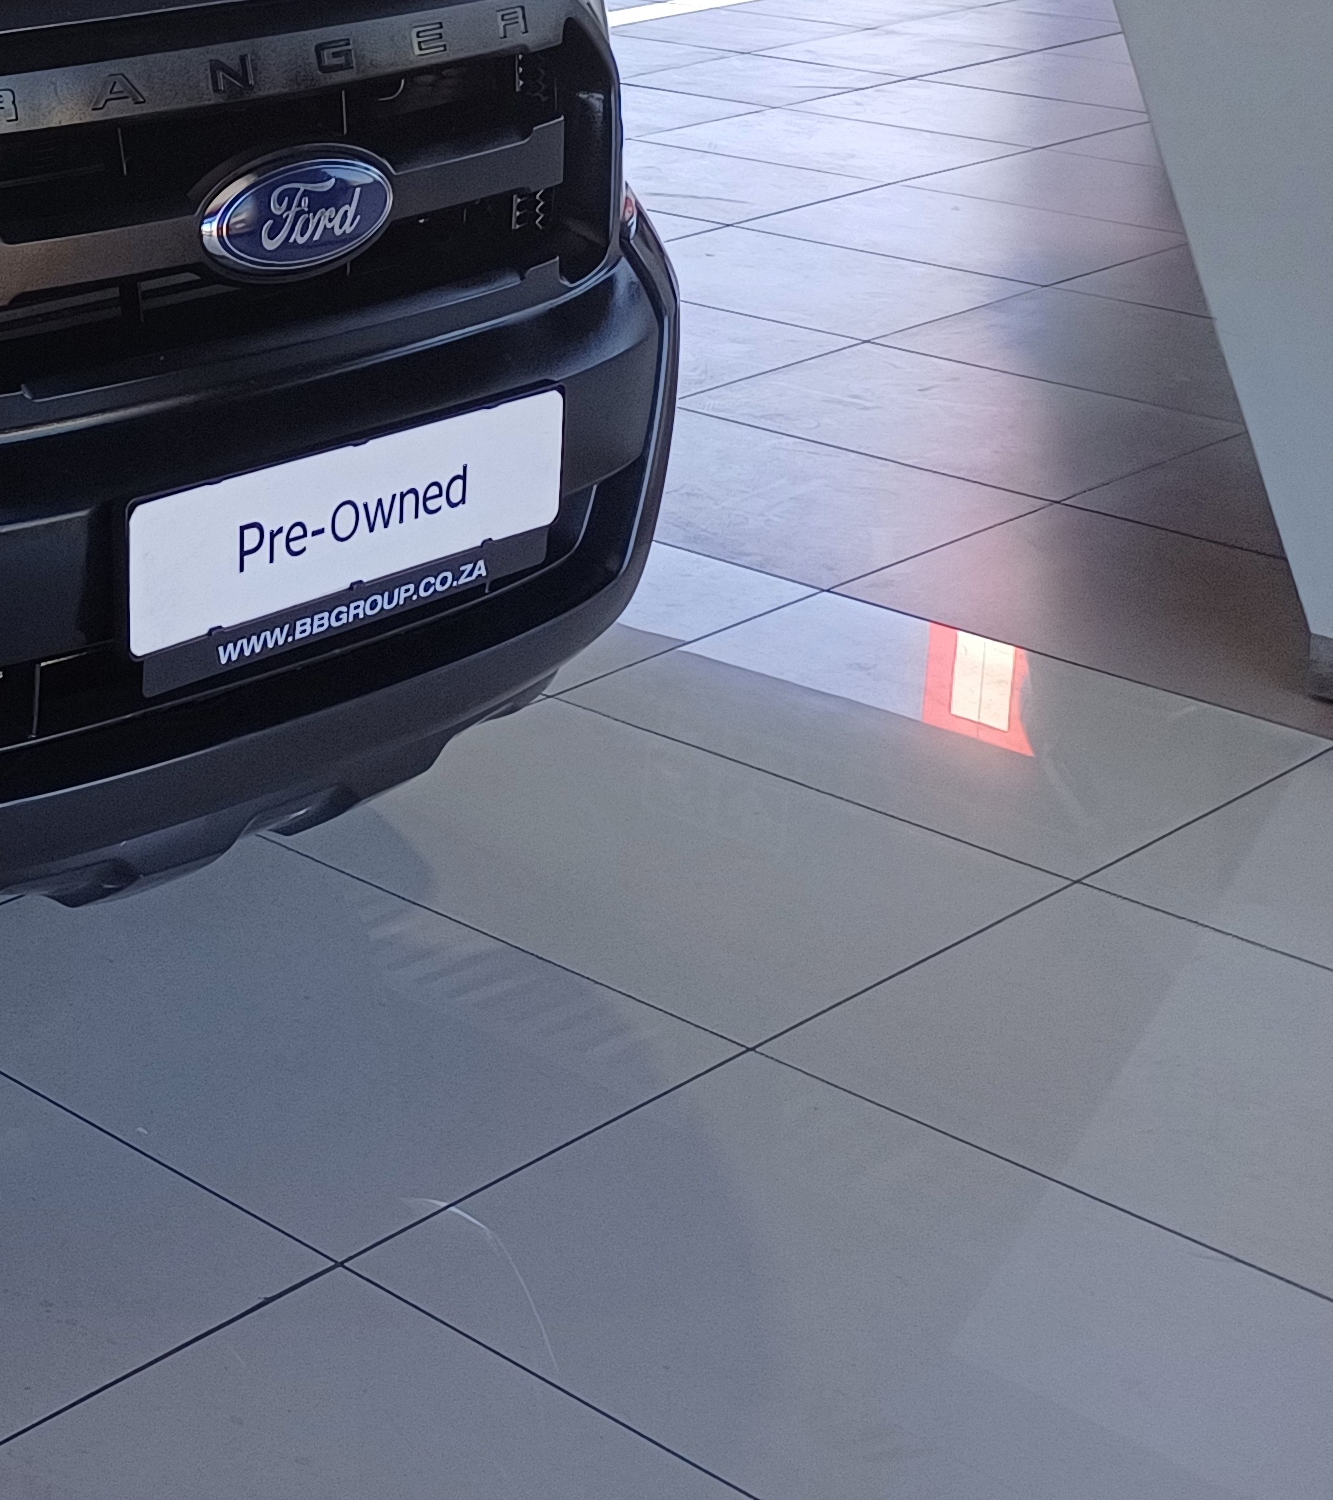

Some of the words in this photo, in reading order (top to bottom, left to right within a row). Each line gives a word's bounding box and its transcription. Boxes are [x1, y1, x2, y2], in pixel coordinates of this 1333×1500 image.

[262, 179, 361, 251] Ford
[238, 464, 468, 573] Pre-Owned
[217, 558, 488, 665] WWW.BBGROUP.CO.ZA
